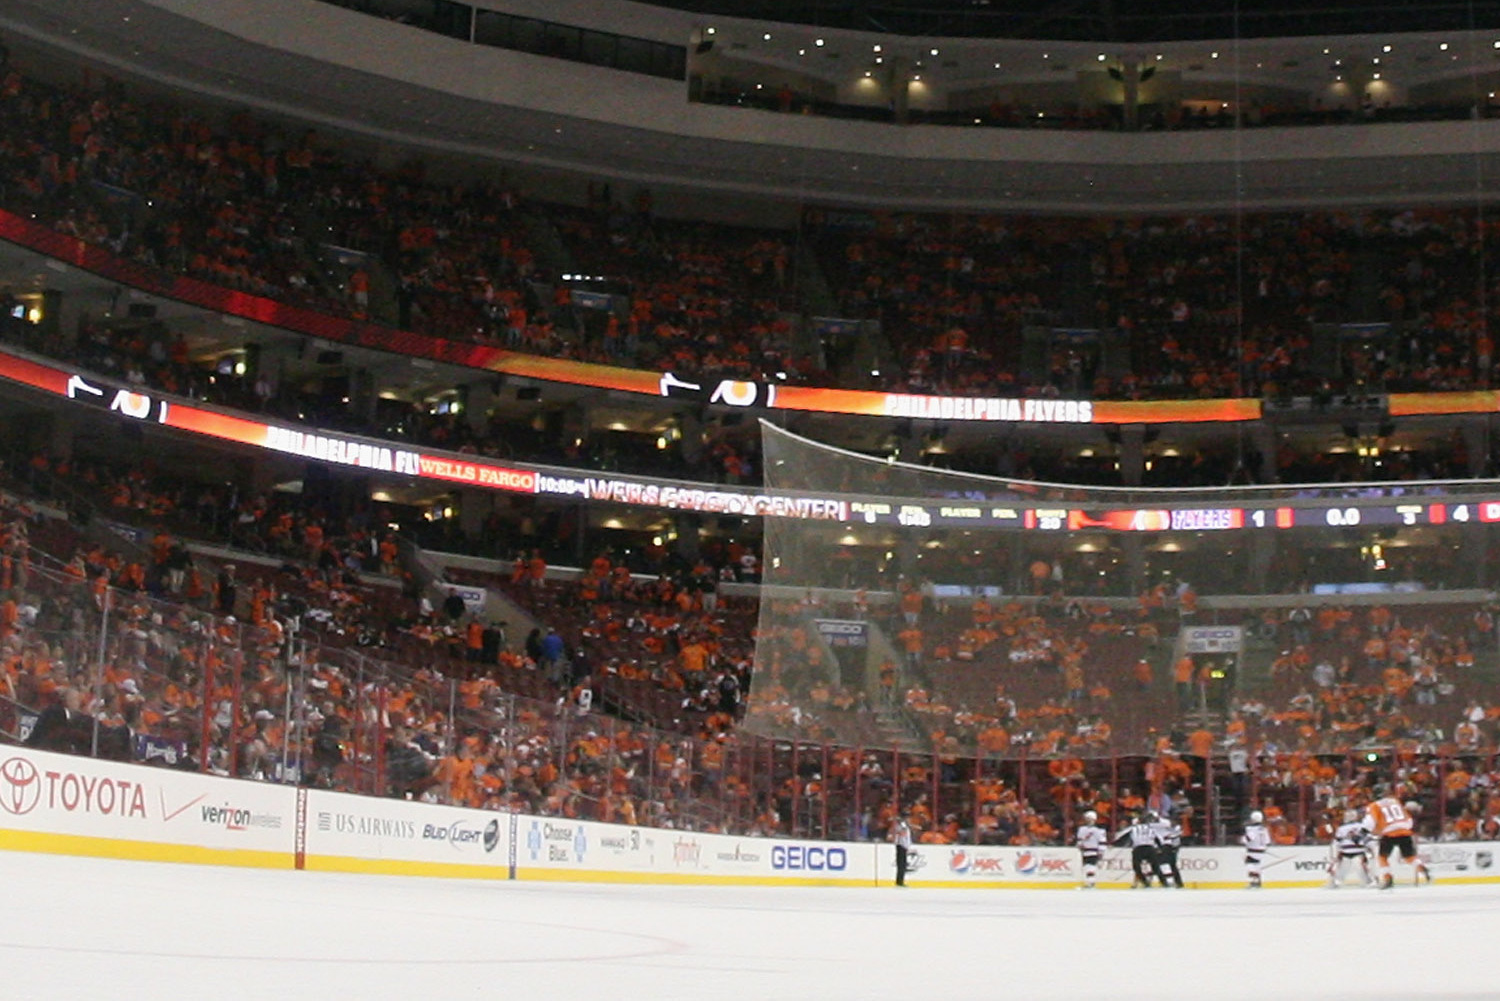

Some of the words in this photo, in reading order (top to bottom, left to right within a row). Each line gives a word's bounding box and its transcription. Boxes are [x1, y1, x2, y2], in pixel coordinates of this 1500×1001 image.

[885, 394, 1021, 421] PHILADELPHIA
[1024, 400, 1092, 422] FLYERS
[420, 458, 476, 482] WELLS
[479, 468, 535, 490] FARGO
[45, 770, 147, 819] TOYOTA
[202, 802, 250, 831] verizon
[336, 815, 356, 834] US
[357, 816, 416, 839] AIRWAYS
[422, 824, 447, 841] BUD
[452, 825, 482, 845] LIGHT
[543, 822, 573, 842] Choose
[771, 845, 847, 871] GEICO
